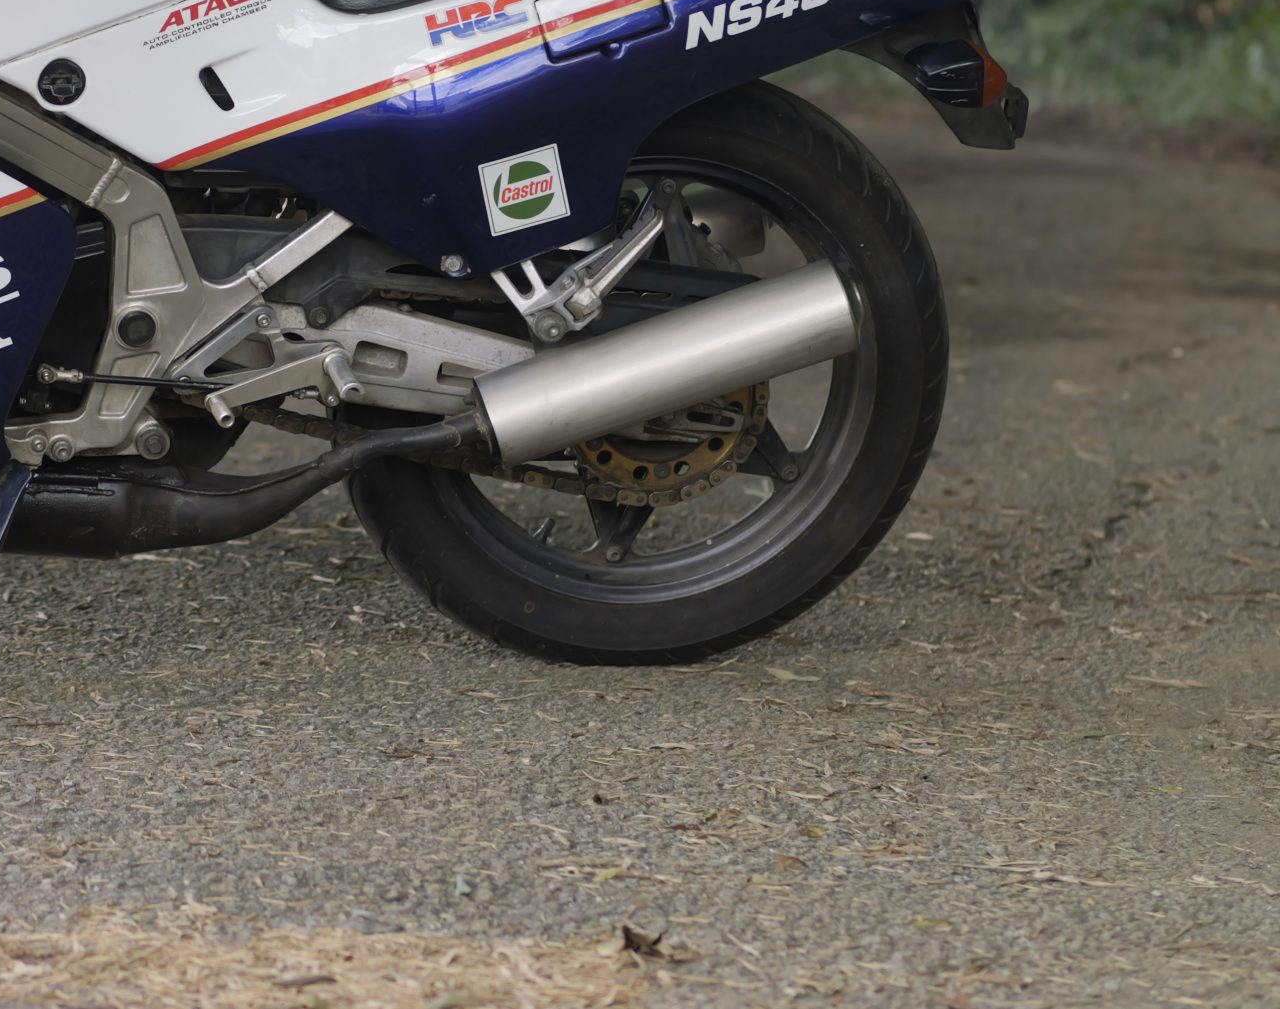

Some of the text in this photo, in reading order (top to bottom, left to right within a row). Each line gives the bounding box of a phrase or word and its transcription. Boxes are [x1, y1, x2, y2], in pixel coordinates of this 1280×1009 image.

[142, 10, 232, 47] AUTO-CONTROLLED
[148, 4, 268, 50] AMPLIFICATION CHAMBER
[501, 175, 554, 204] Castrol
